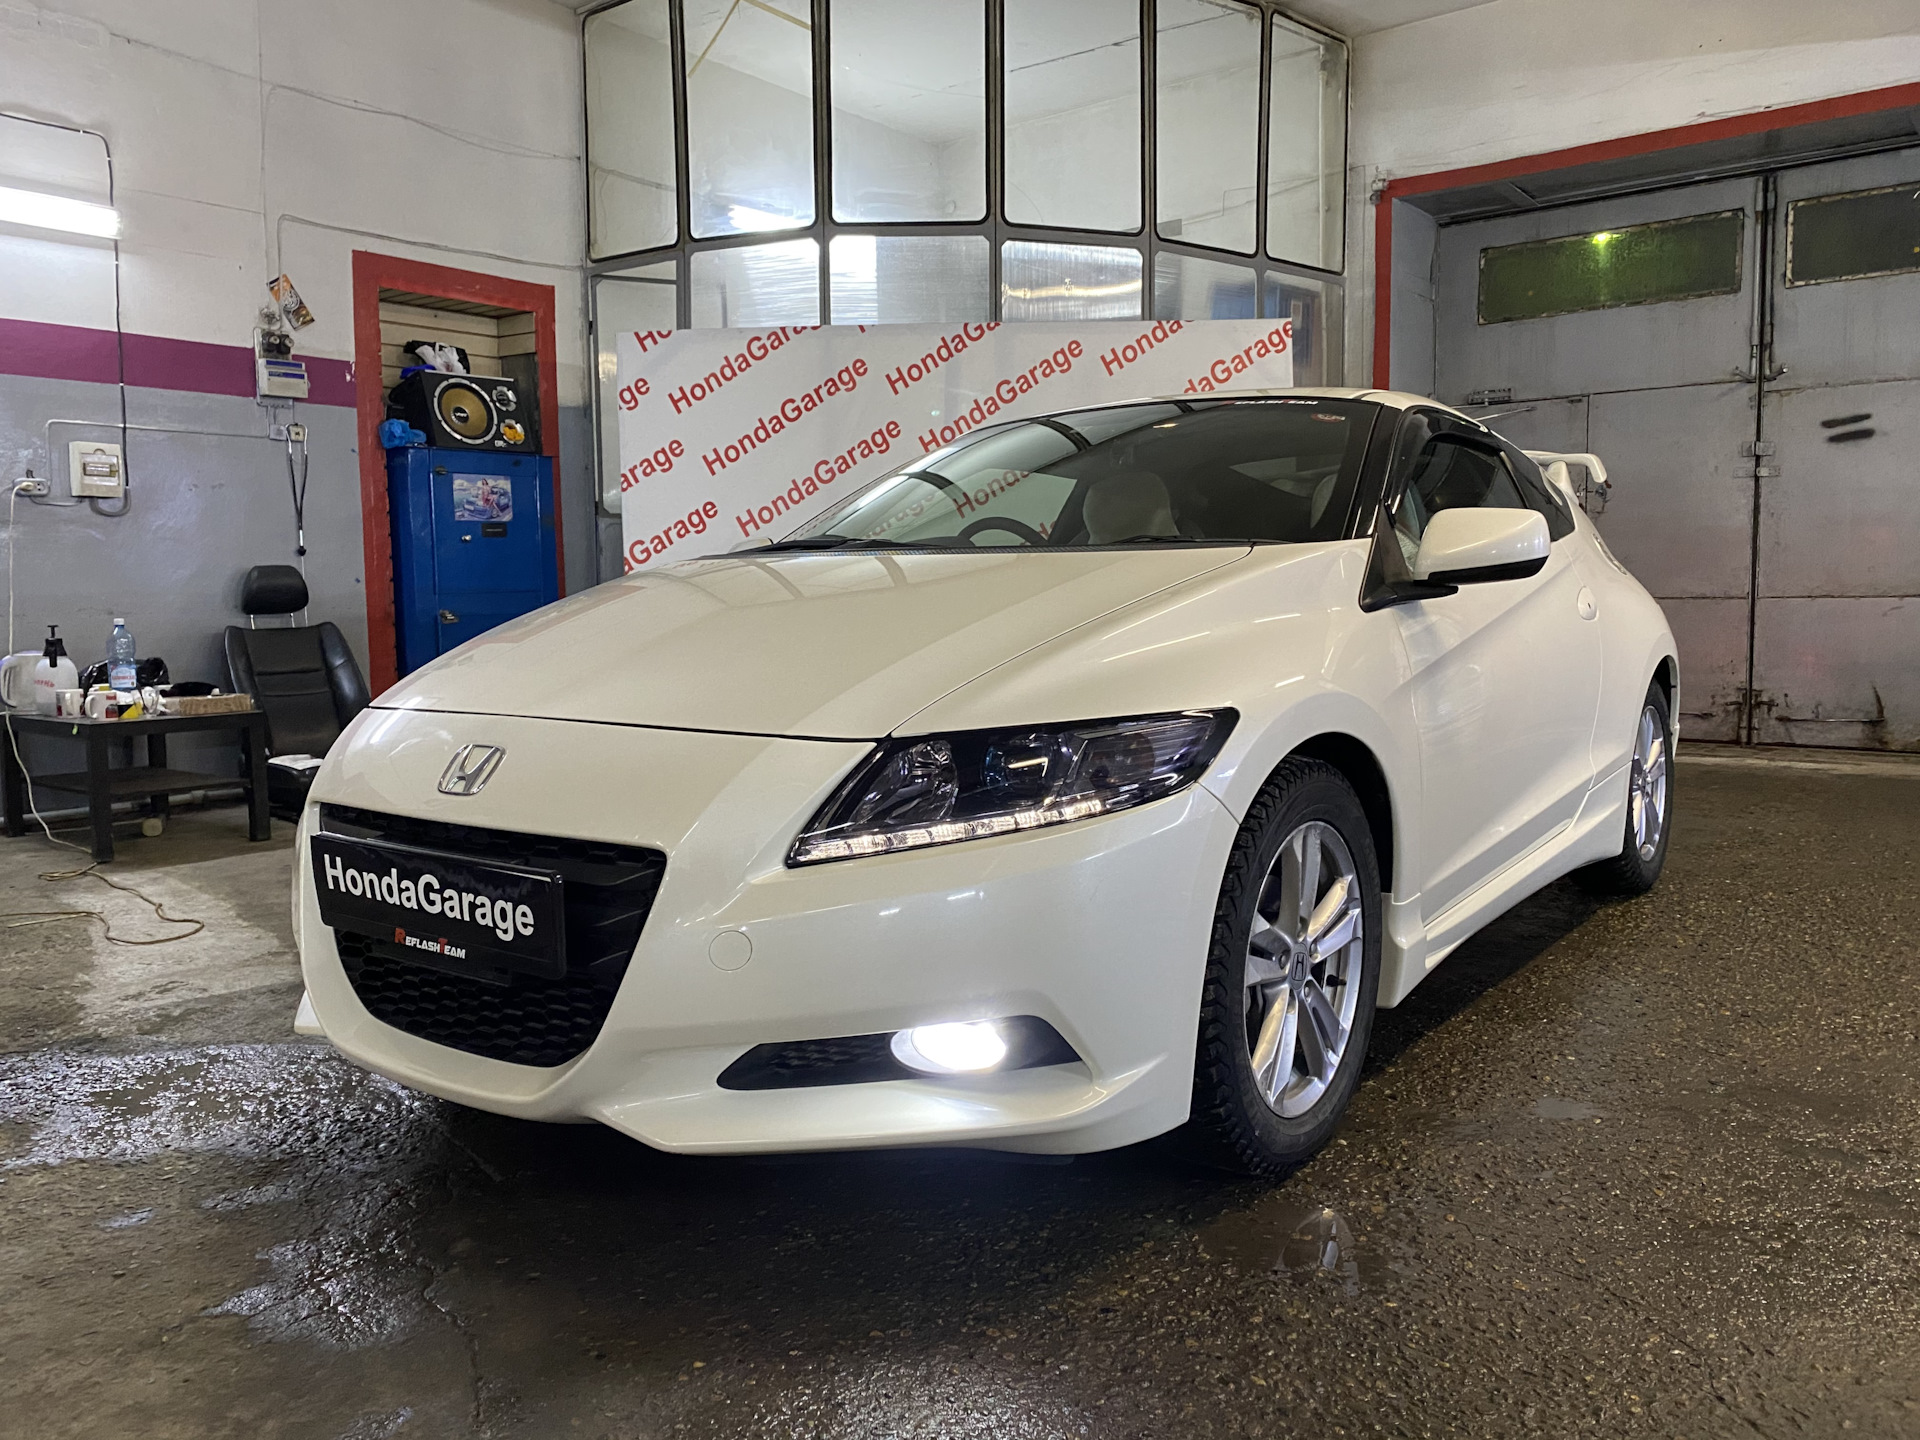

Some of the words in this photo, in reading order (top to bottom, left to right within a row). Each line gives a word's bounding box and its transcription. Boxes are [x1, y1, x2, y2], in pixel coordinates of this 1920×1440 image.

[618, 377, 651, 411] ge
[919, 340, 1084, 454] HondaGarage
[1100, 319, 1195, 377] Honda
[702, 358, 868, 476] HondaGarage
[736, 420, 902, 538] HondaGarage
[323, 853, 535, 941] HondaGarage
